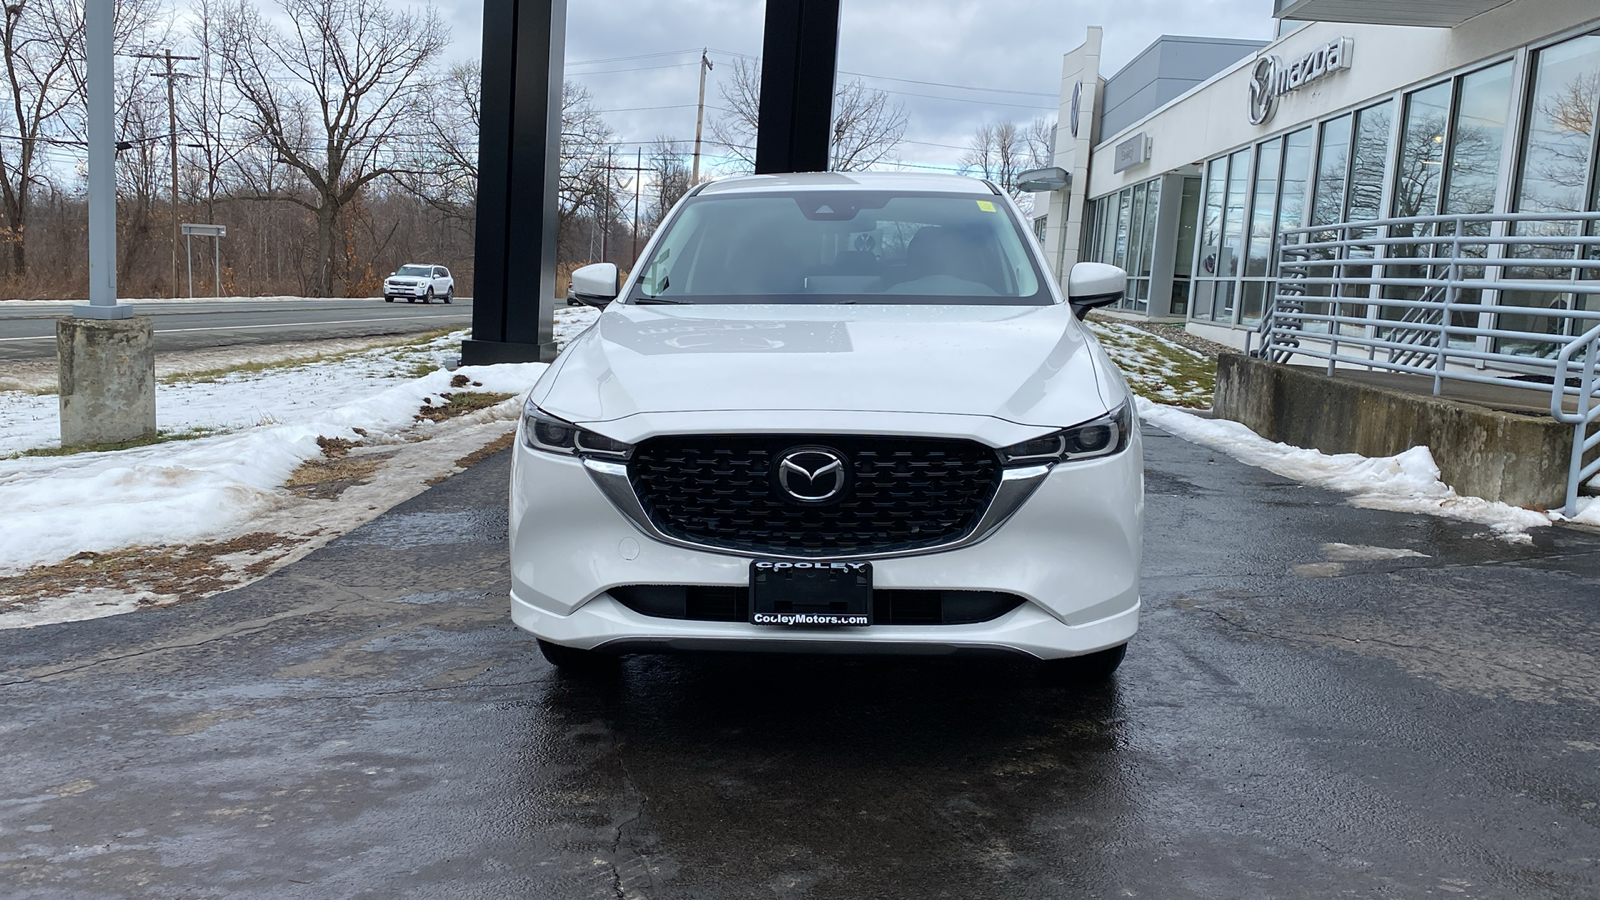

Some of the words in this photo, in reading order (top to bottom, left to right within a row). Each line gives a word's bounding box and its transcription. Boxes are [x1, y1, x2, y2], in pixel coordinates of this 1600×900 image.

[1275, 36, 1352, 97] mazda
[755, 561, 865, 569] COOLEY
[754, 613, 868, 625] CooleyMotors.com
